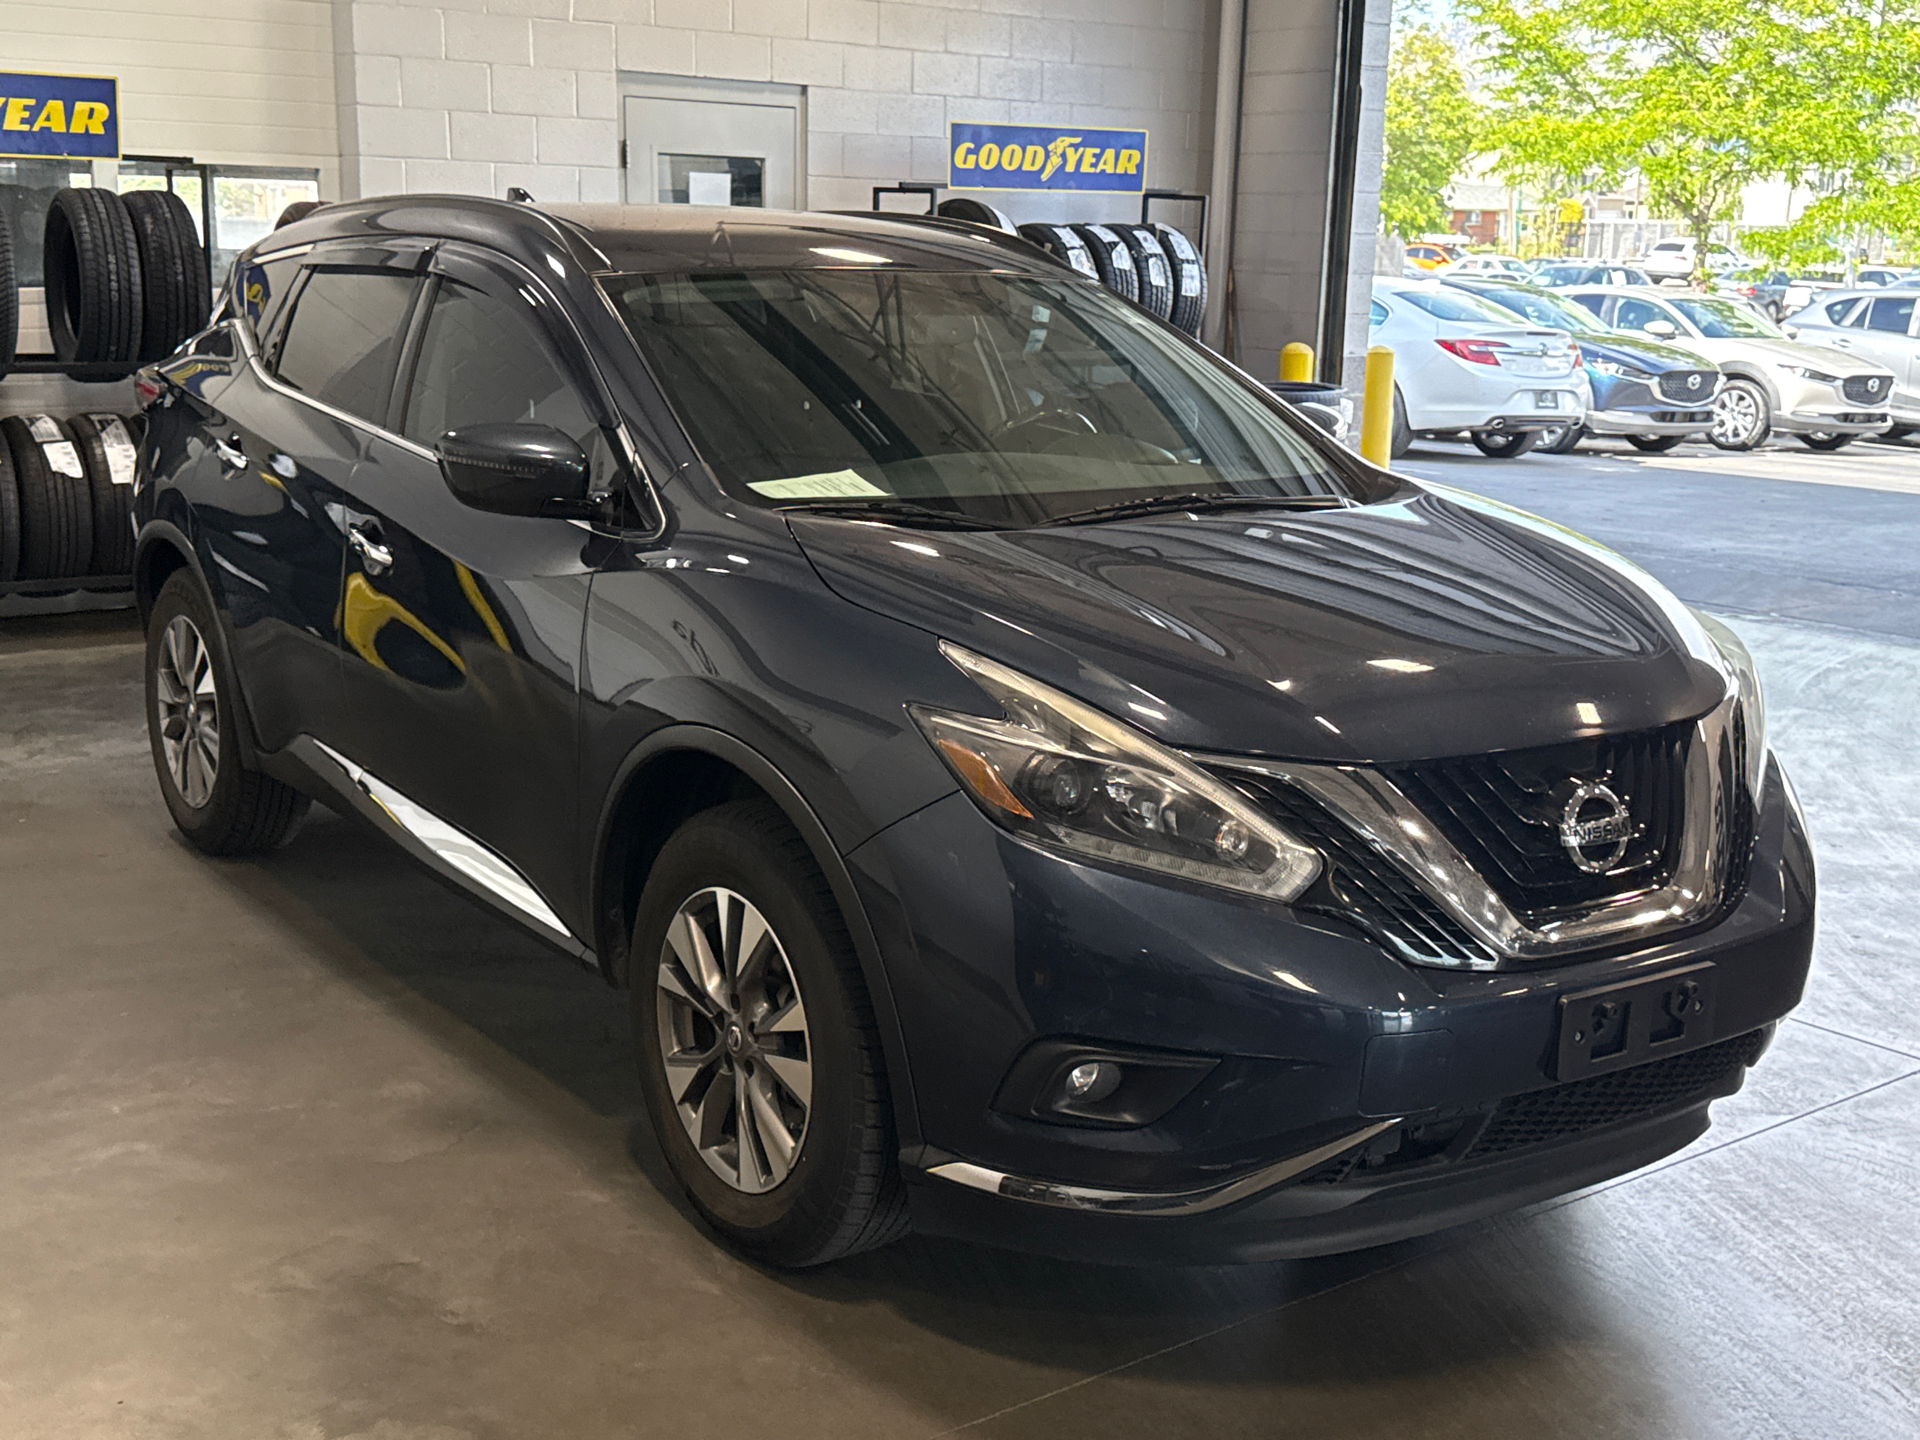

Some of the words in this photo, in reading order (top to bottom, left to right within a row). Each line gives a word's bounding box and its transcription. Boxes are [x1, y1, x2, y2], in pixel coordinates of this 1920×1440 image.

[0, 97, 110, 135] EAR
[953, 141, 1141, 175] GOODYEAR
[1573, 820, 1629, 841] NISSAN
